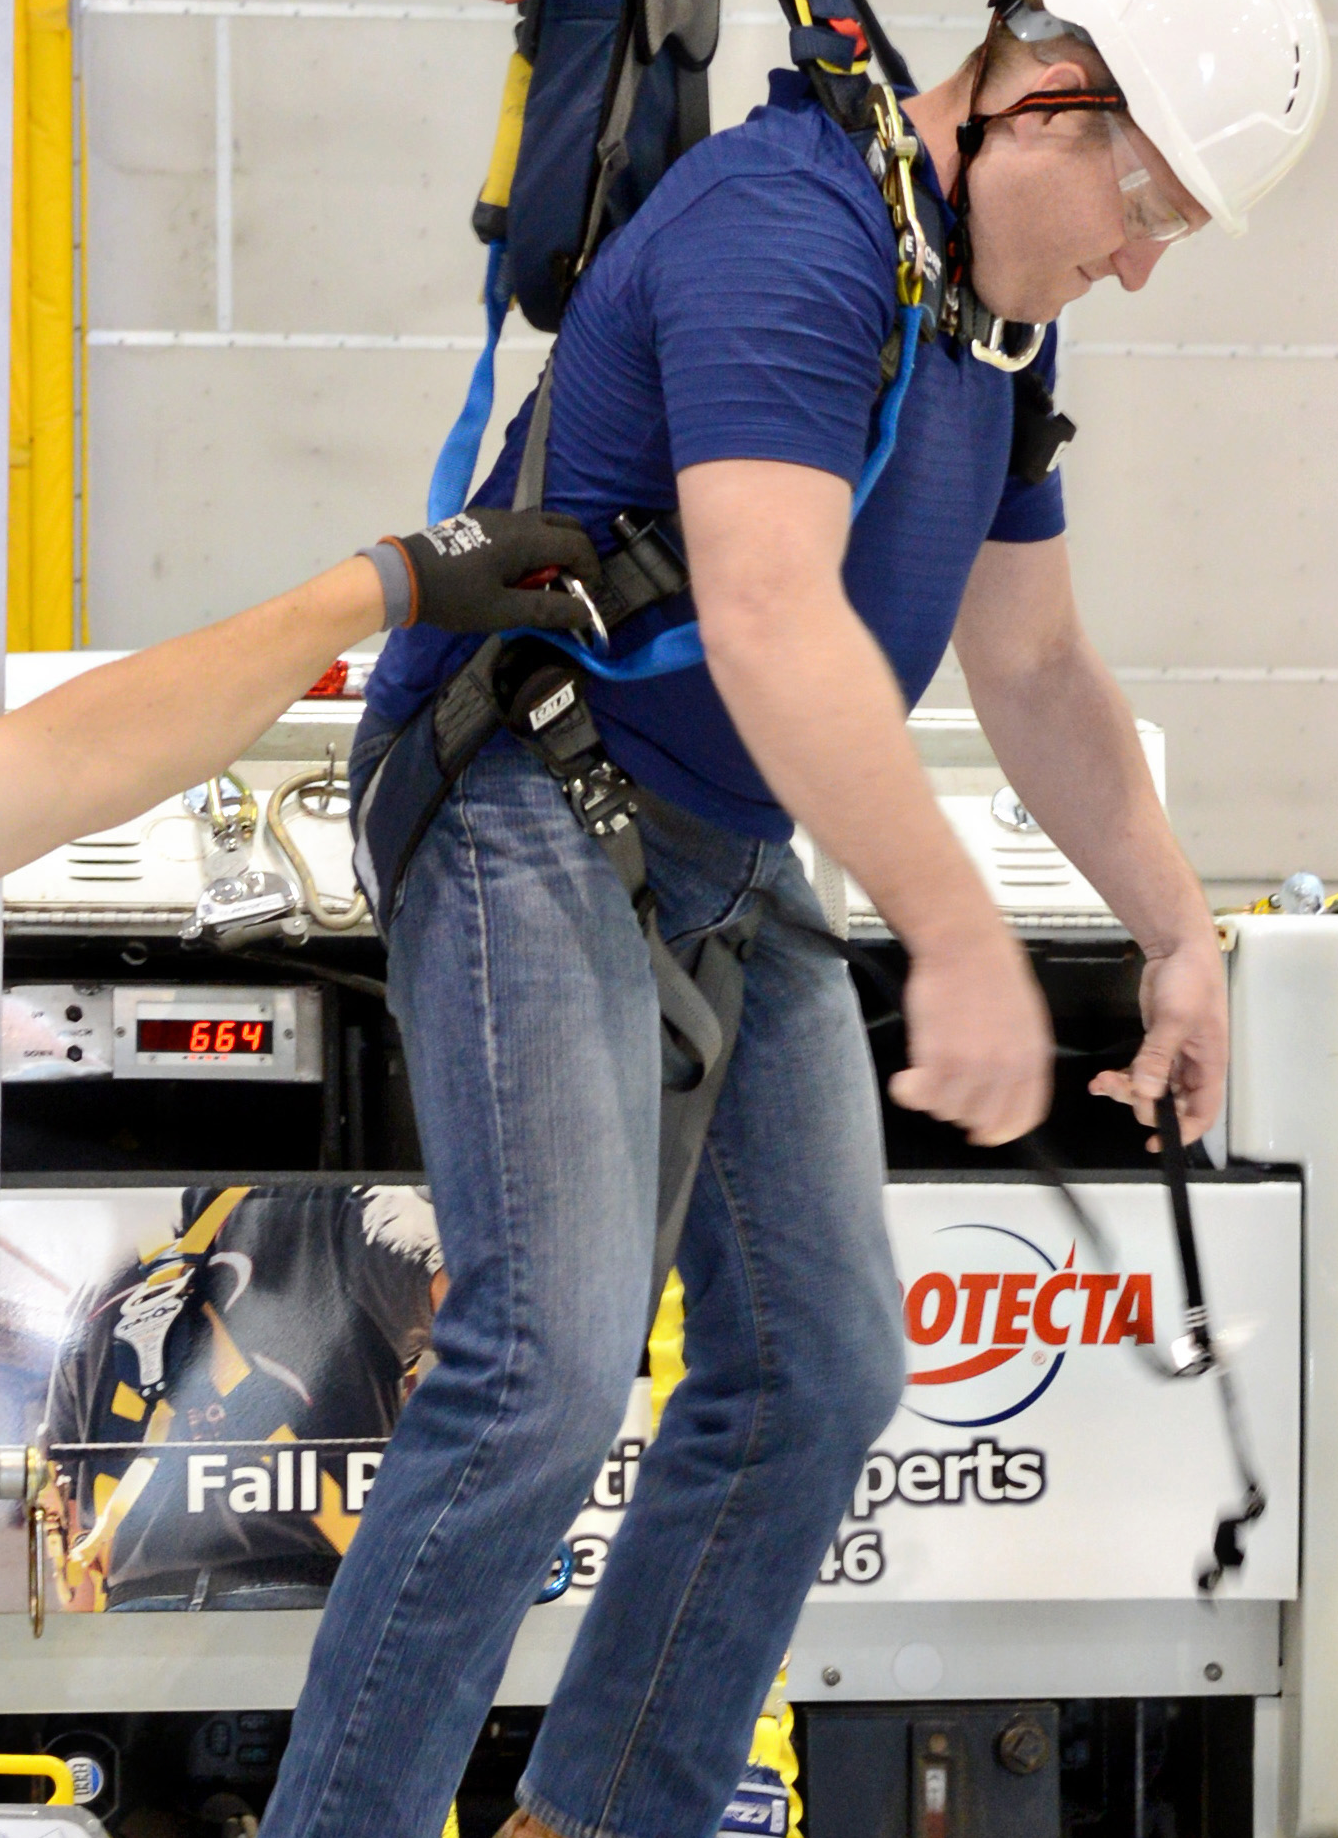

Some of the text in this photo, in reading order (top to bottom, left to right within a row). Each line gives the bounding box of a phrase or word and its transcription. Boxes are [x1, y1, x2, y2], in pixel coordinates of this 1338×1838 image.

[190, 1021, 262, 1052] 664
[899, 1272, 1155, 1346] OTECTA
[188, 1450, 317, 1513] Fall
[852, 1442, 1044, 1516] perts
